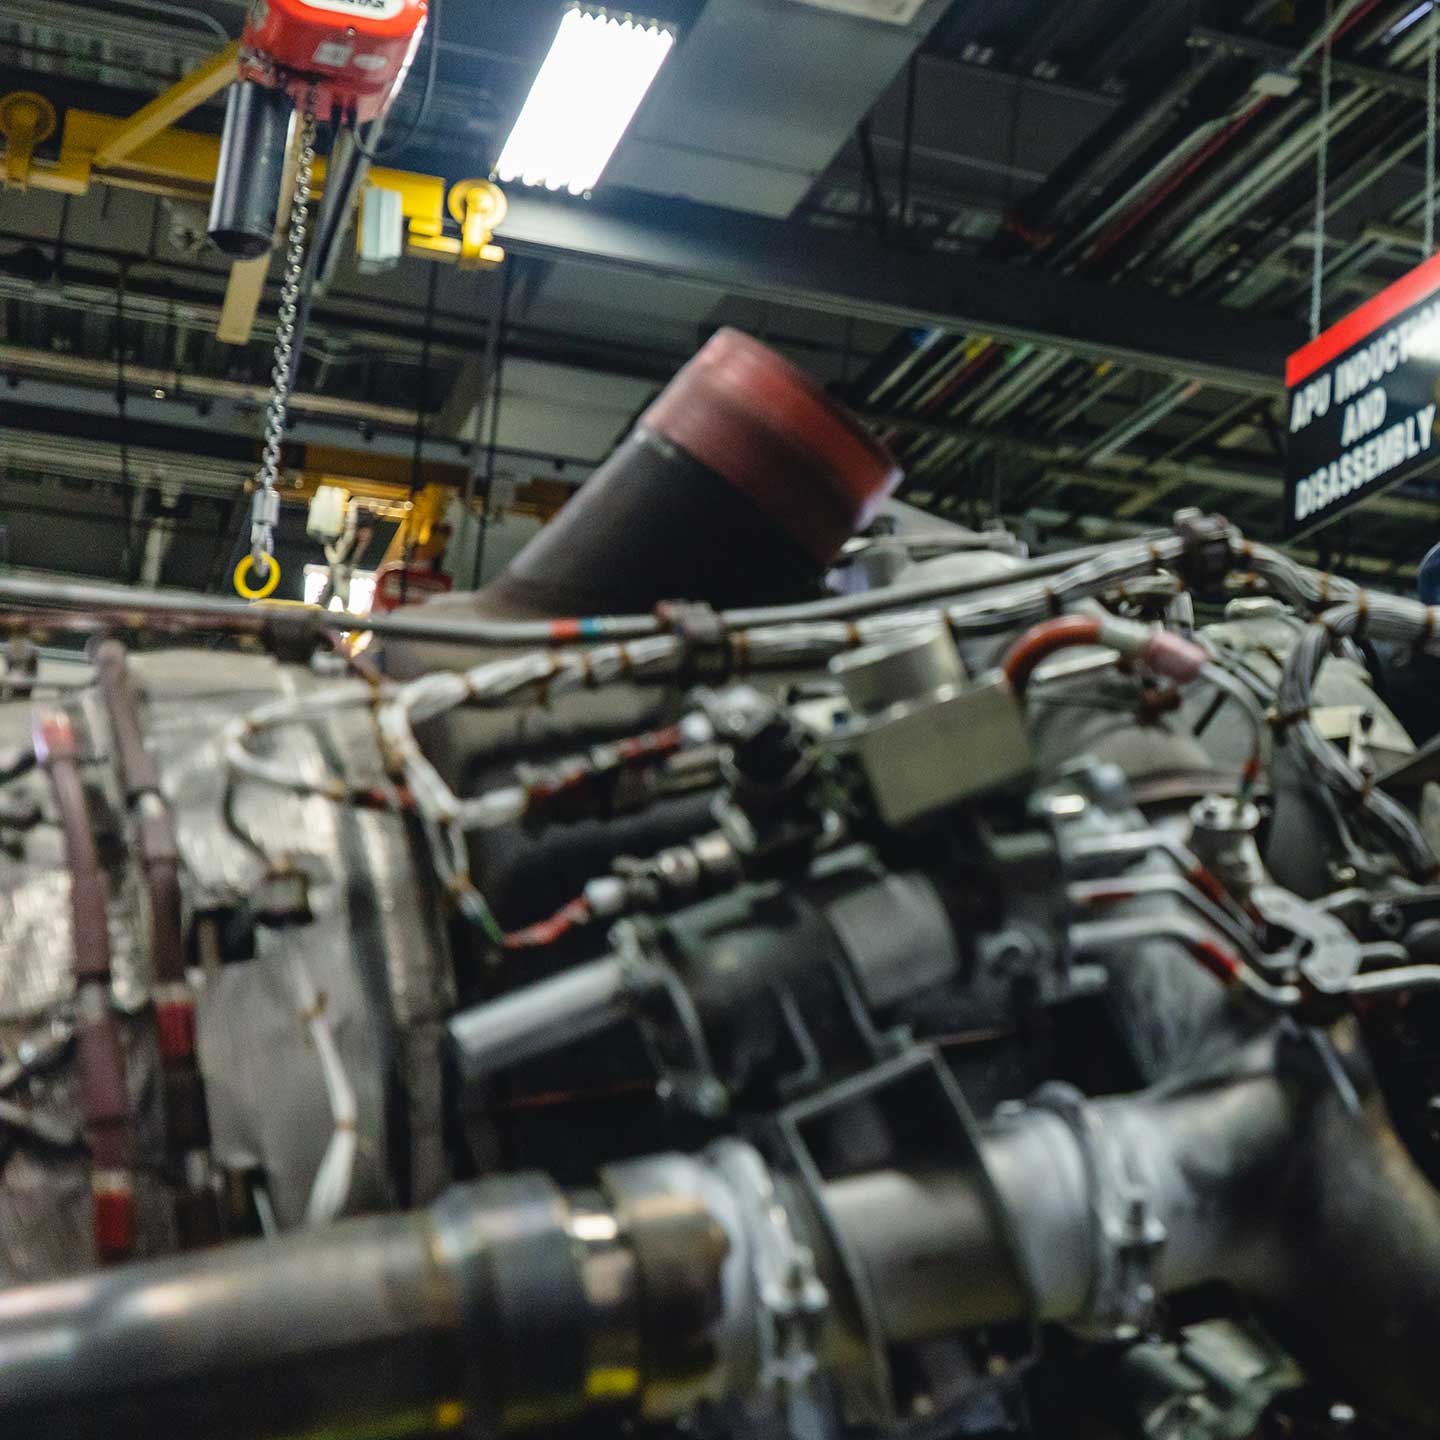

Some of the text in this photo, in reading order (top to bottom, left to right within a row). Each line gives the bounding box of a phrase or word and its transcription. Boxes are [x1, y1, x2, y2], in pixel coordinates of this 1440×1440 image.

[1290, 373, 1332, 433] APU
[1341, 386, 1388, 447] AND
[1295, 403, 1437, 521] DISASSEMBLY
